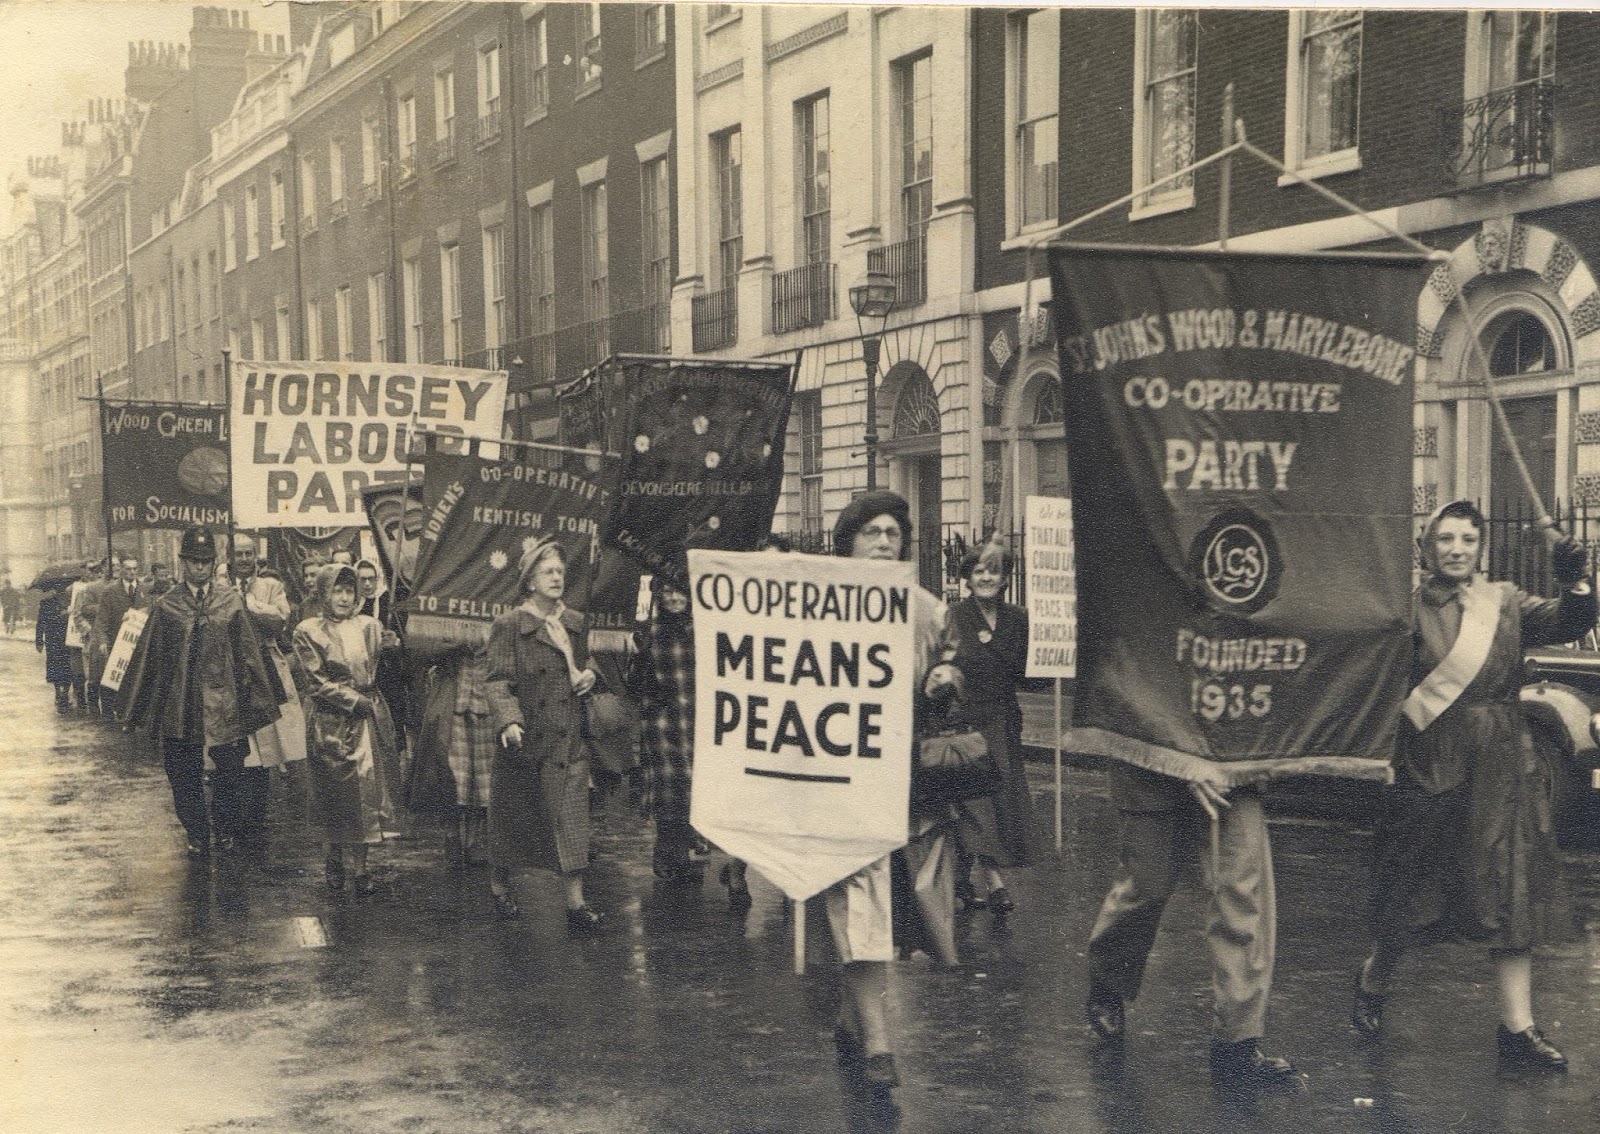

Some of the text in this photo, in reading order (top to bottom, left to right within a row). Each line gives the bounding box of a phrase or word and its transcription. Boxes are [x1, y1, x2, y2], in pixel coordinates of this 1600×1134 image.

[1169, 307, 1237, 352] WOOD
[1239, 308, 1258, 349] &
[1263, 309, 1416, 386] MARYLEBONE
[243, 372, 493, 421] HORNSEY
[1123, 377, 1343, 414] CO-OPERATIVE
[157, 411, 213, 439] GREEN
[219, 413, 228, 442] L
[1162, 438, 1299, 491] PARTY
[620, 481, 702, 496] DEVONSHIRE
[112, 495, 229, 525] FOR SOCIALISM
[473, 507, 598, 535] KENTISH TOWN
[418, 595, 438, 612] TO
[716, 631, 894, 689] MEANS
[1034, 647, 1077, 667] SOCIALI
[1176, 627, 1308, 672] FOUNDED
[1191, 678, 1273, 721] 1935
[714, 690, 882, 759] PEACE
